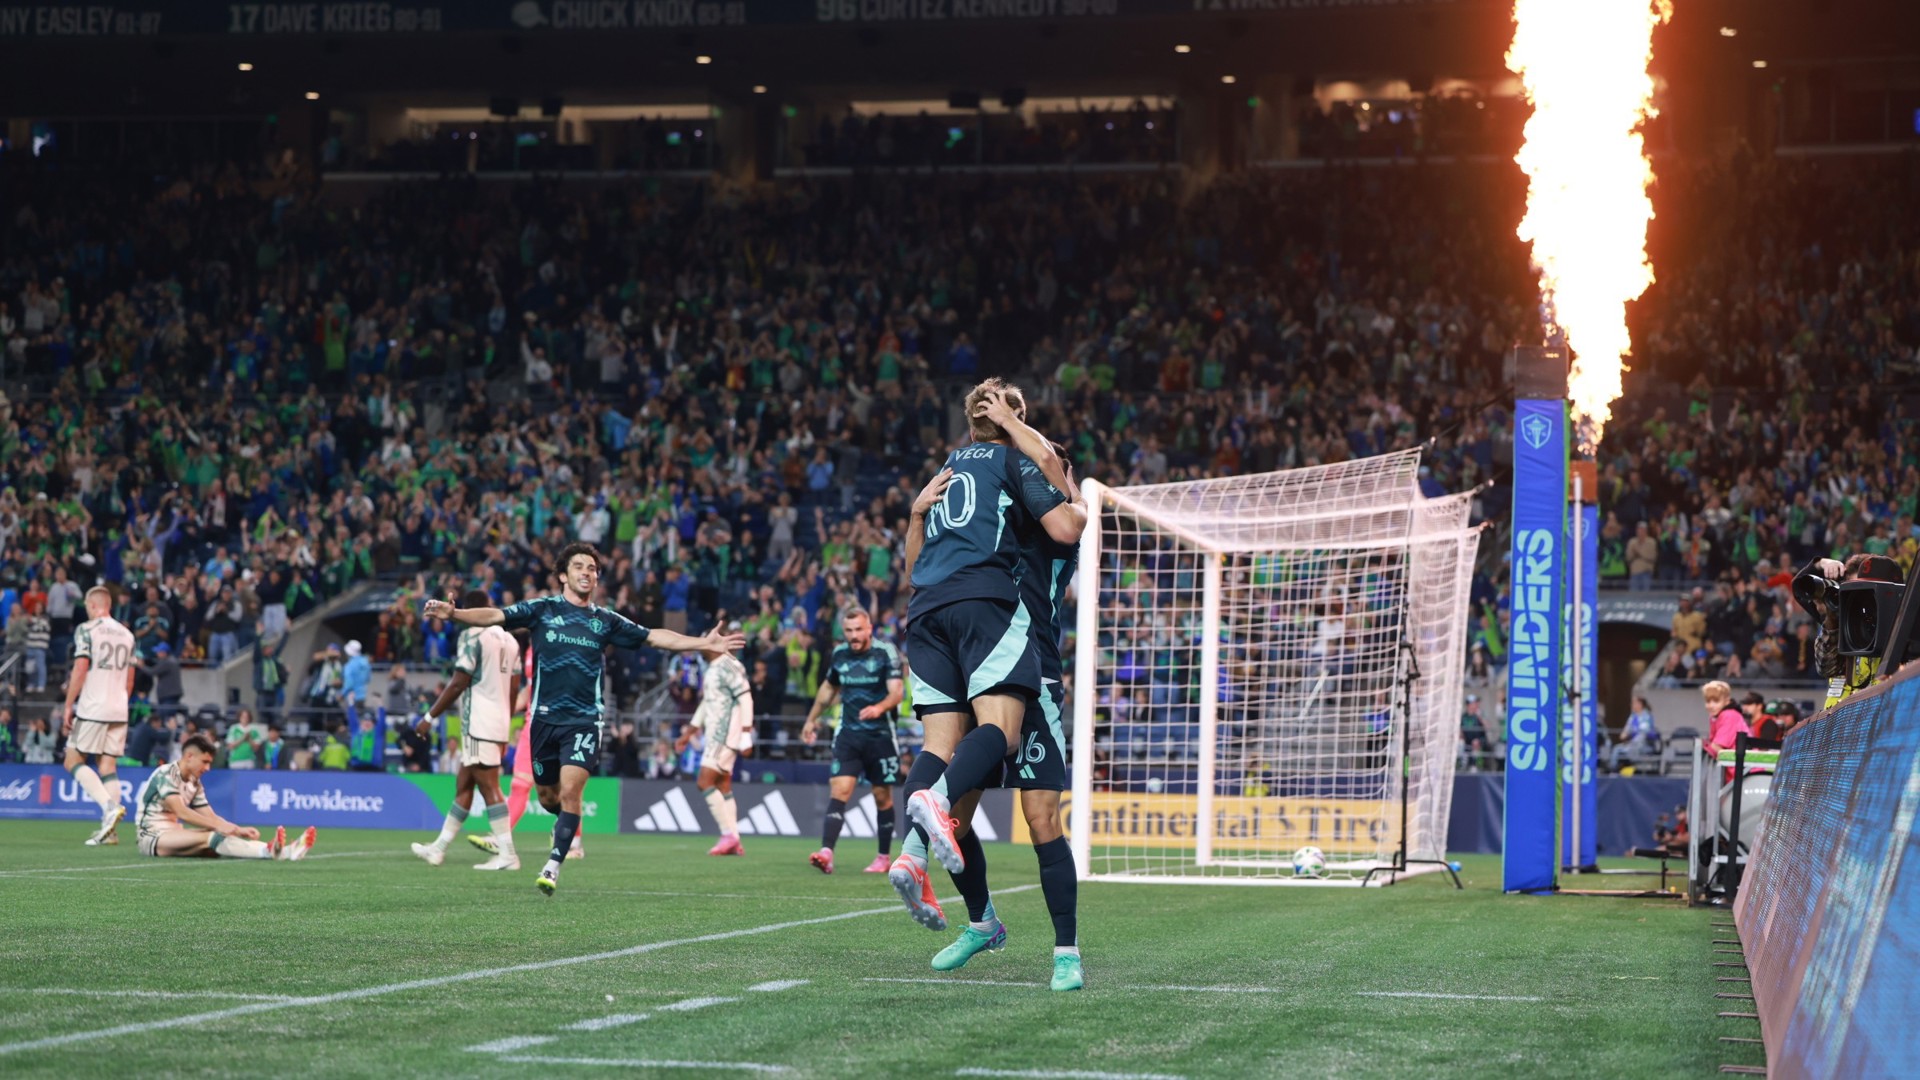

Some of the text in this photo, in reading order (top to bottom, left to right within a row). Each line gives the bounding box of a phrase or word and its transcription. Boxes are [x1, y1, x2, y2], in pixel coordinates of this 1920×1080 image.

[36, 6, 114, 35] EASLEY
[228, 4, 262, 33] 17
[263, 4, 318, 32] DAVE
[323, 3, 391, 32] KRIEG
[552, 1, 628, 28] CHUCK
[633, 0, 695, 27] KNOX
[955, 448, 994, 461] VEGA
[926, 471, 976, 539] 10
[97, 641, 128, 671] 20
[1510, 528, 1554, 771] SOUNDERS
[573, 733, 596, 755] 14
[1015, 731, 1046, 764] 16
[880, 757, 899, 775] 13
[281, 788, 384, 812] Providence
[1060, 800, 1389, 843] ntinetal Tire
